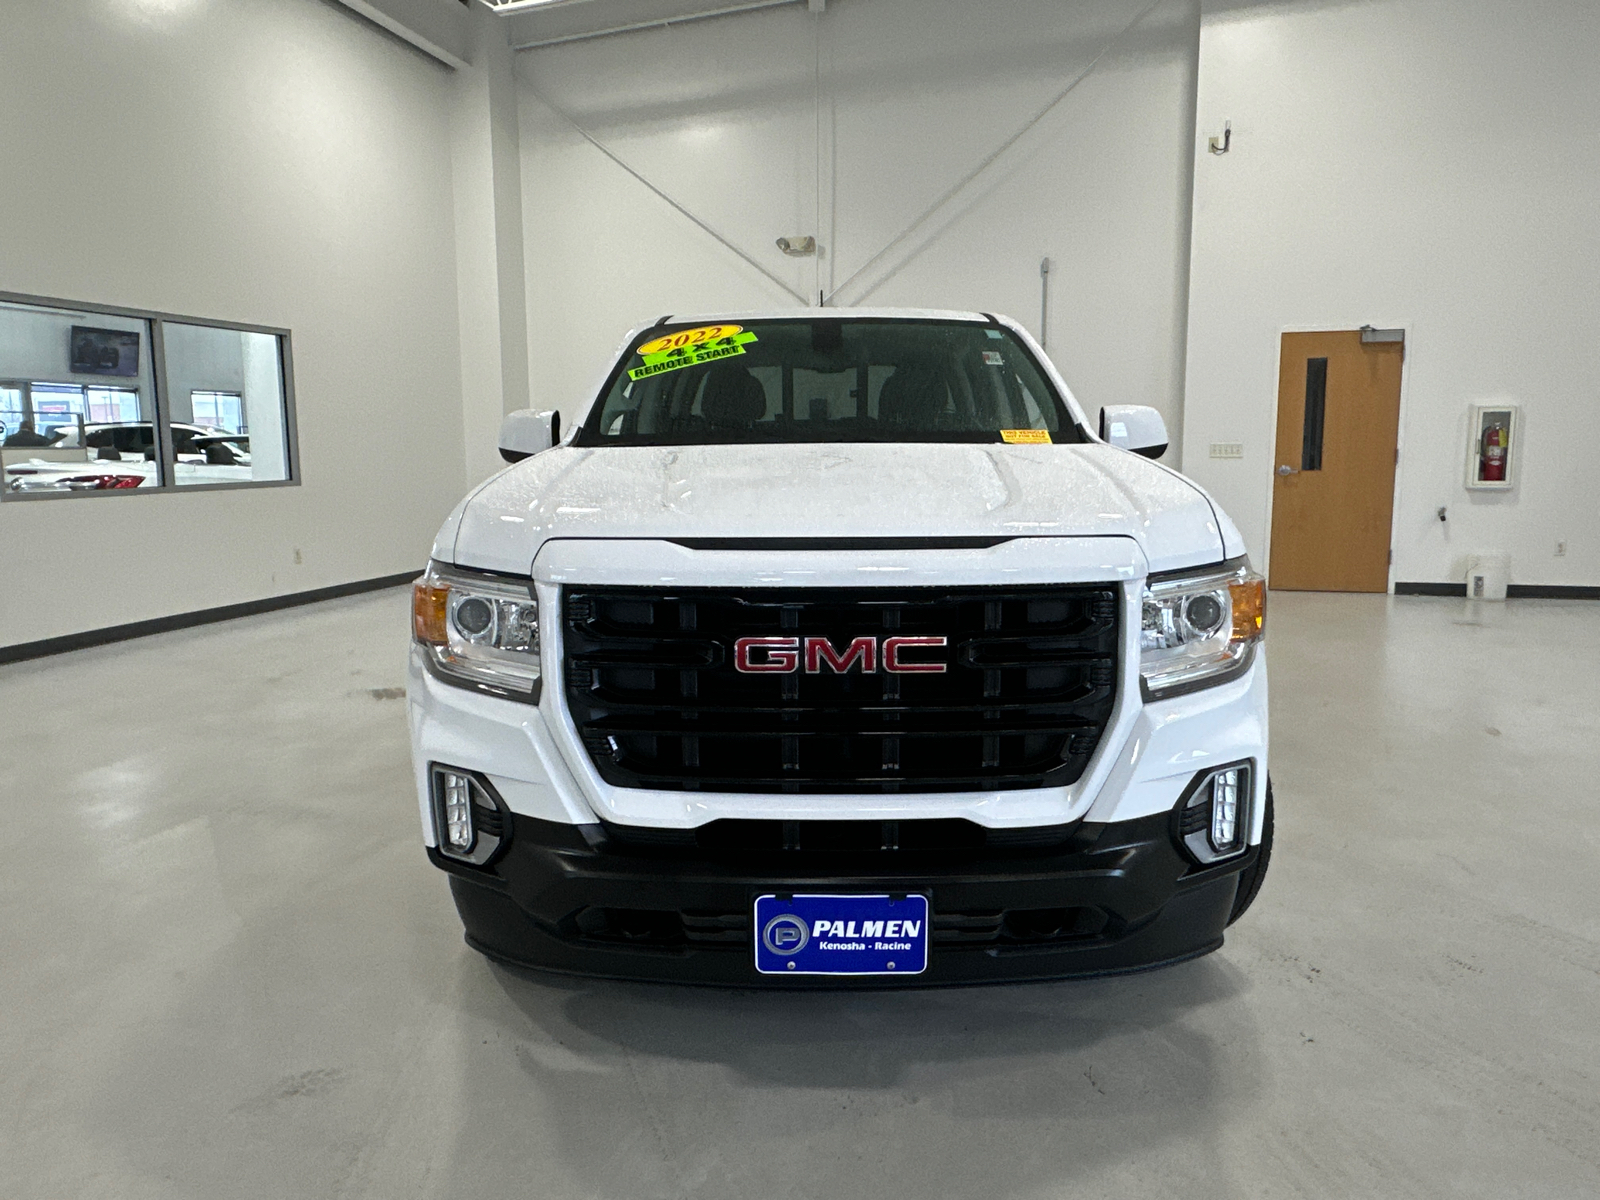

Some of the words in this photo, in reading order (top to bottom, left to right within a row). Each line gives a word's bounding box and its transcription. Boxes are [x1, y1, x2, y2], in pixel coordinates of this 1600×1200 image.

[657, 327, 722, 351] 2022
[634, 355, 693, 378] REMOTE
[695, 345, 741, 362] START
[734, 636, 947, 674] GMC
[812, 920, 921, 938] PALMEN
[819, 941, 865, 950] Kenosha
[874, 941, 912, 950] Racine
